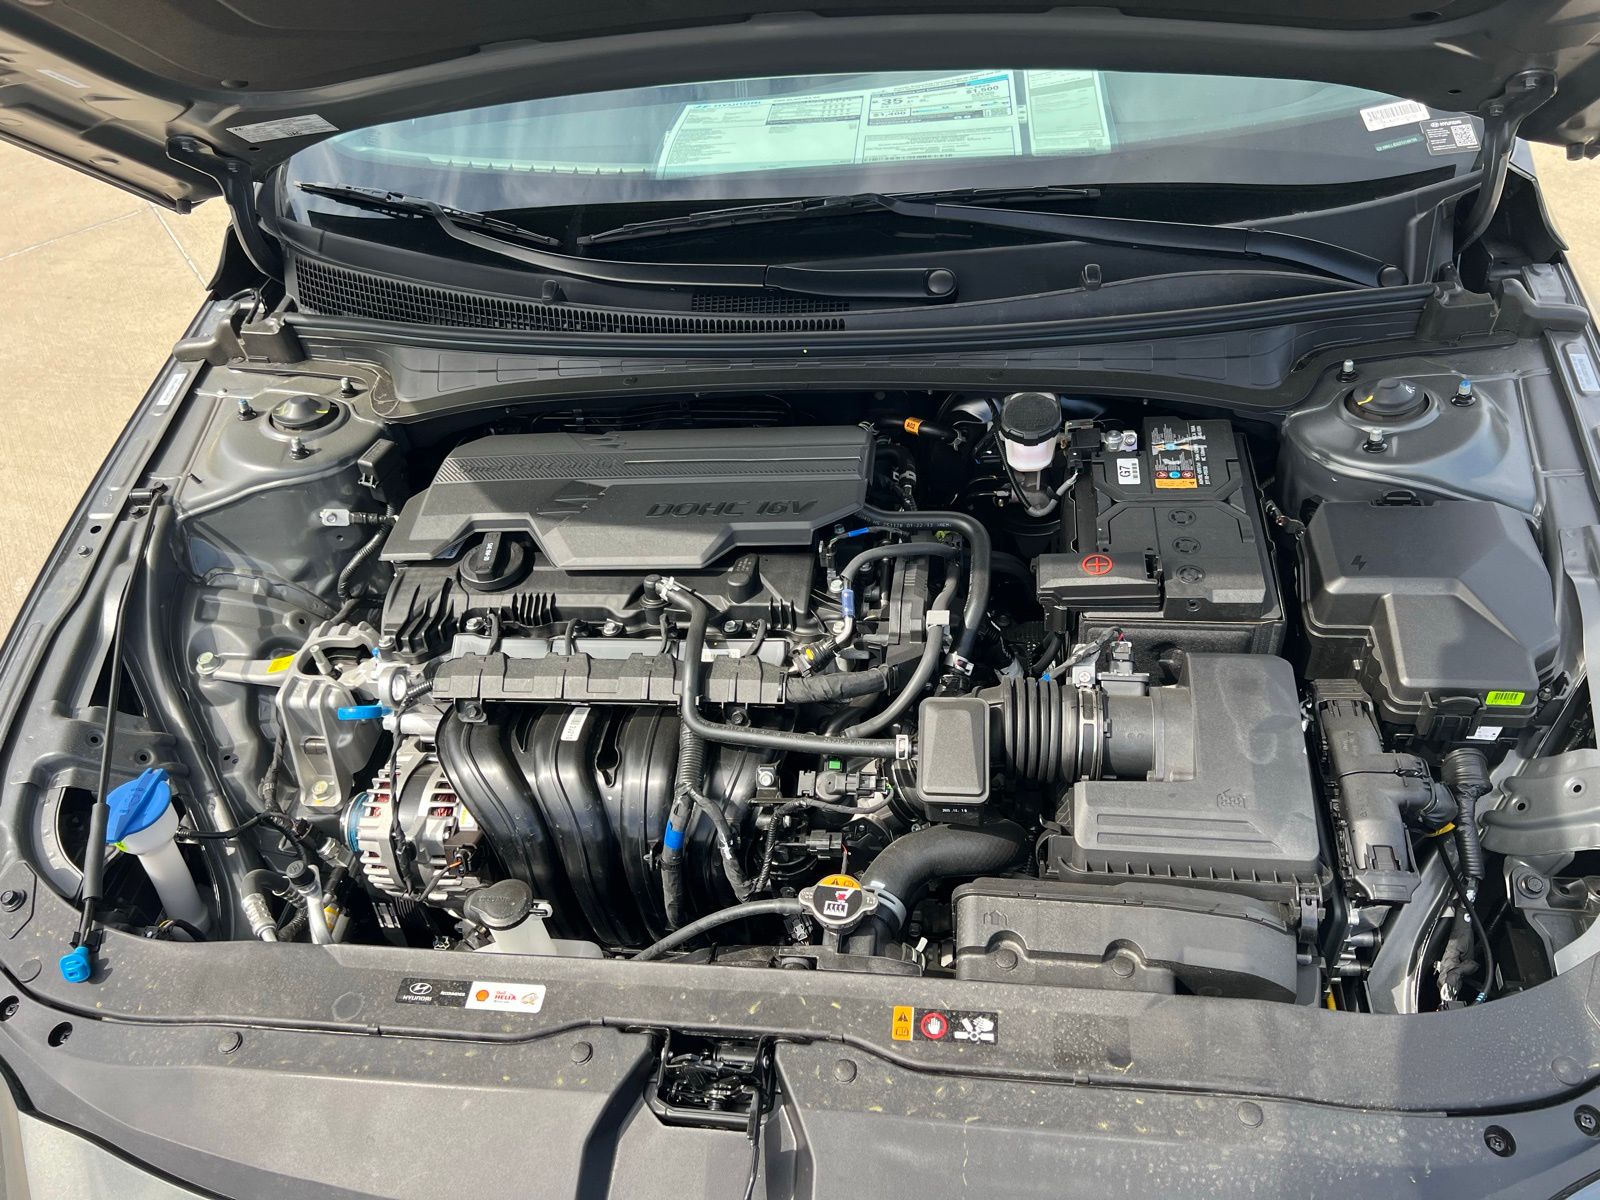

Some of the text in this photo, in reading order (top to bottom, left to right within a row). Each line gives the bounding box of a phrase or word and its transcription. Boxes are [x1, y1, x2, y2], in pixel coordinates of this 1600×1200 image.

[881, 97, 903, 106] 35
[1119, 465, 1131, 478] G7
[646, 499, 817, 518] DOHC 16V
